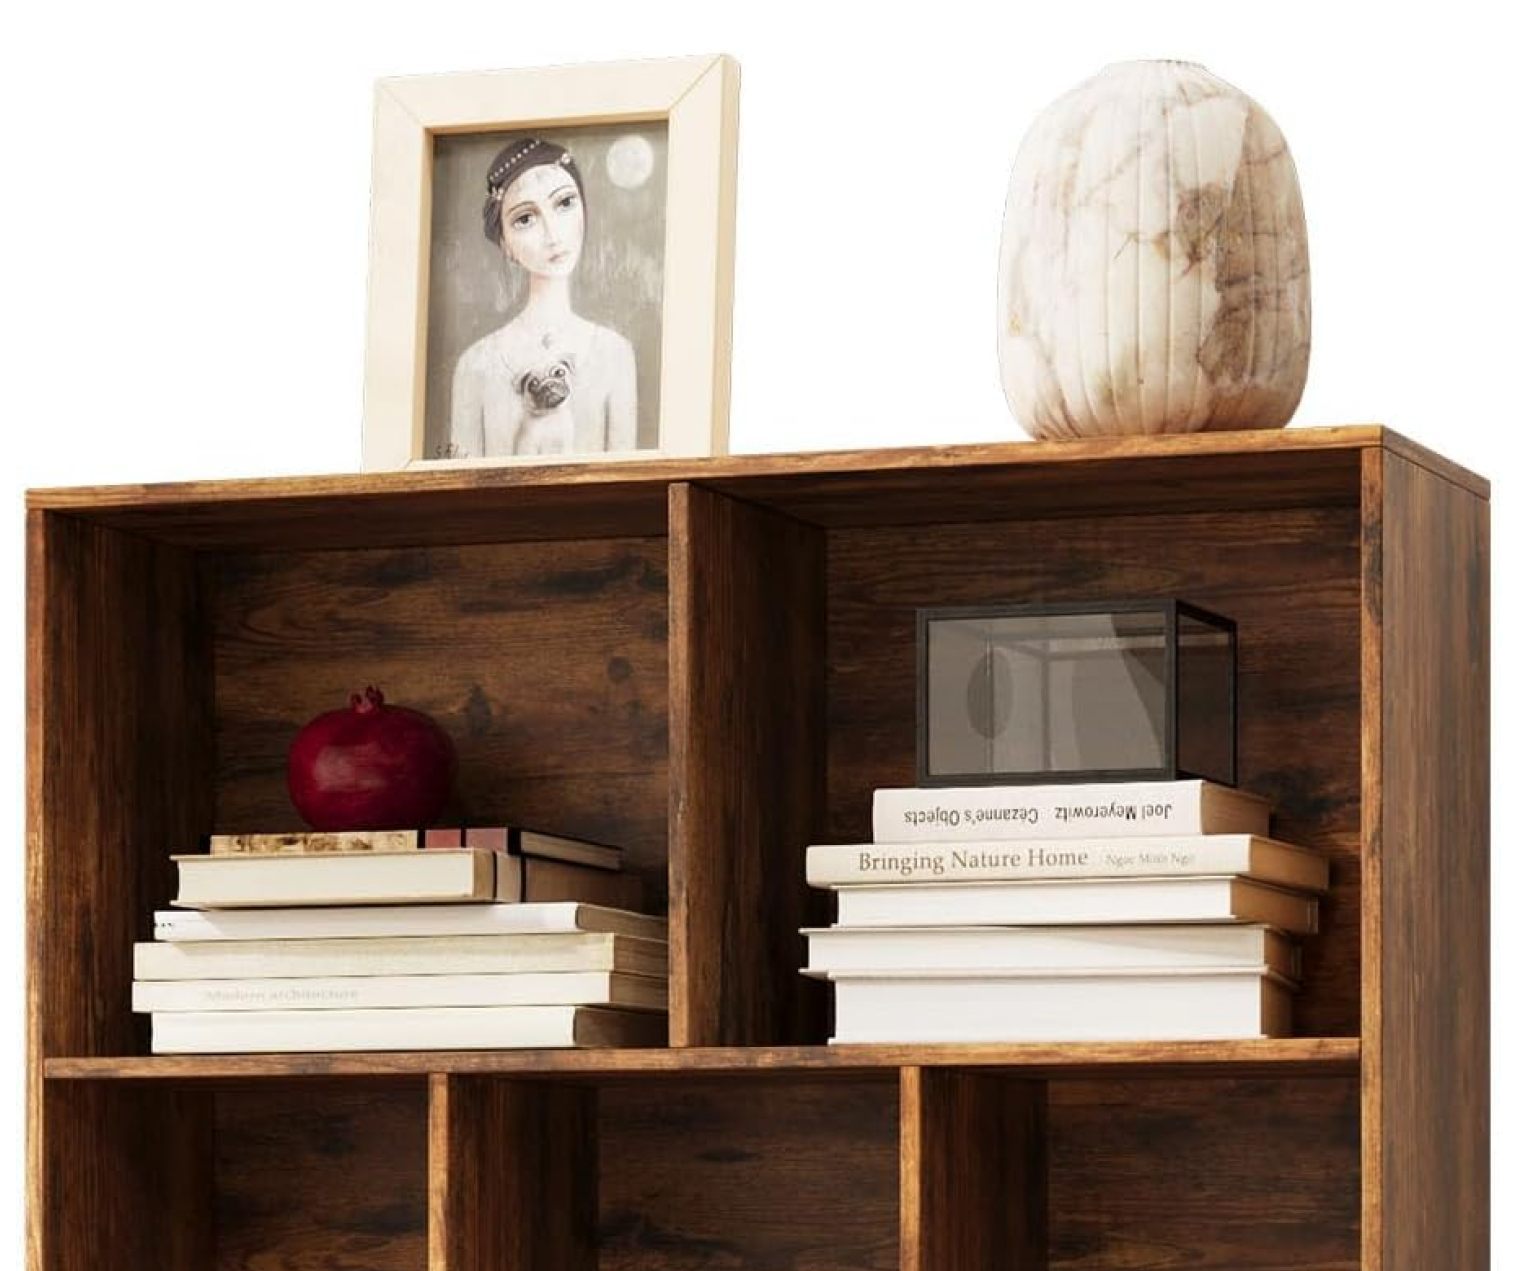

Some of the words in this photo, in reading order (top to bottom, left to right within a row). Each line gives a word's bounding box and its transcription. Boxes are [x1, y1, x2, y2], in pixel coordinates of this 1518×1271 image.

[904, 805, 960, 826] Objects
[1054, 802, 1137, 824] Meyerowitz
[1141, 803, 1173, 820] Joel
[859, 852, 944, 874] Bringing
[951, 850, 1021, 869] Nature
[1028, 848, 1089, 867] Home
